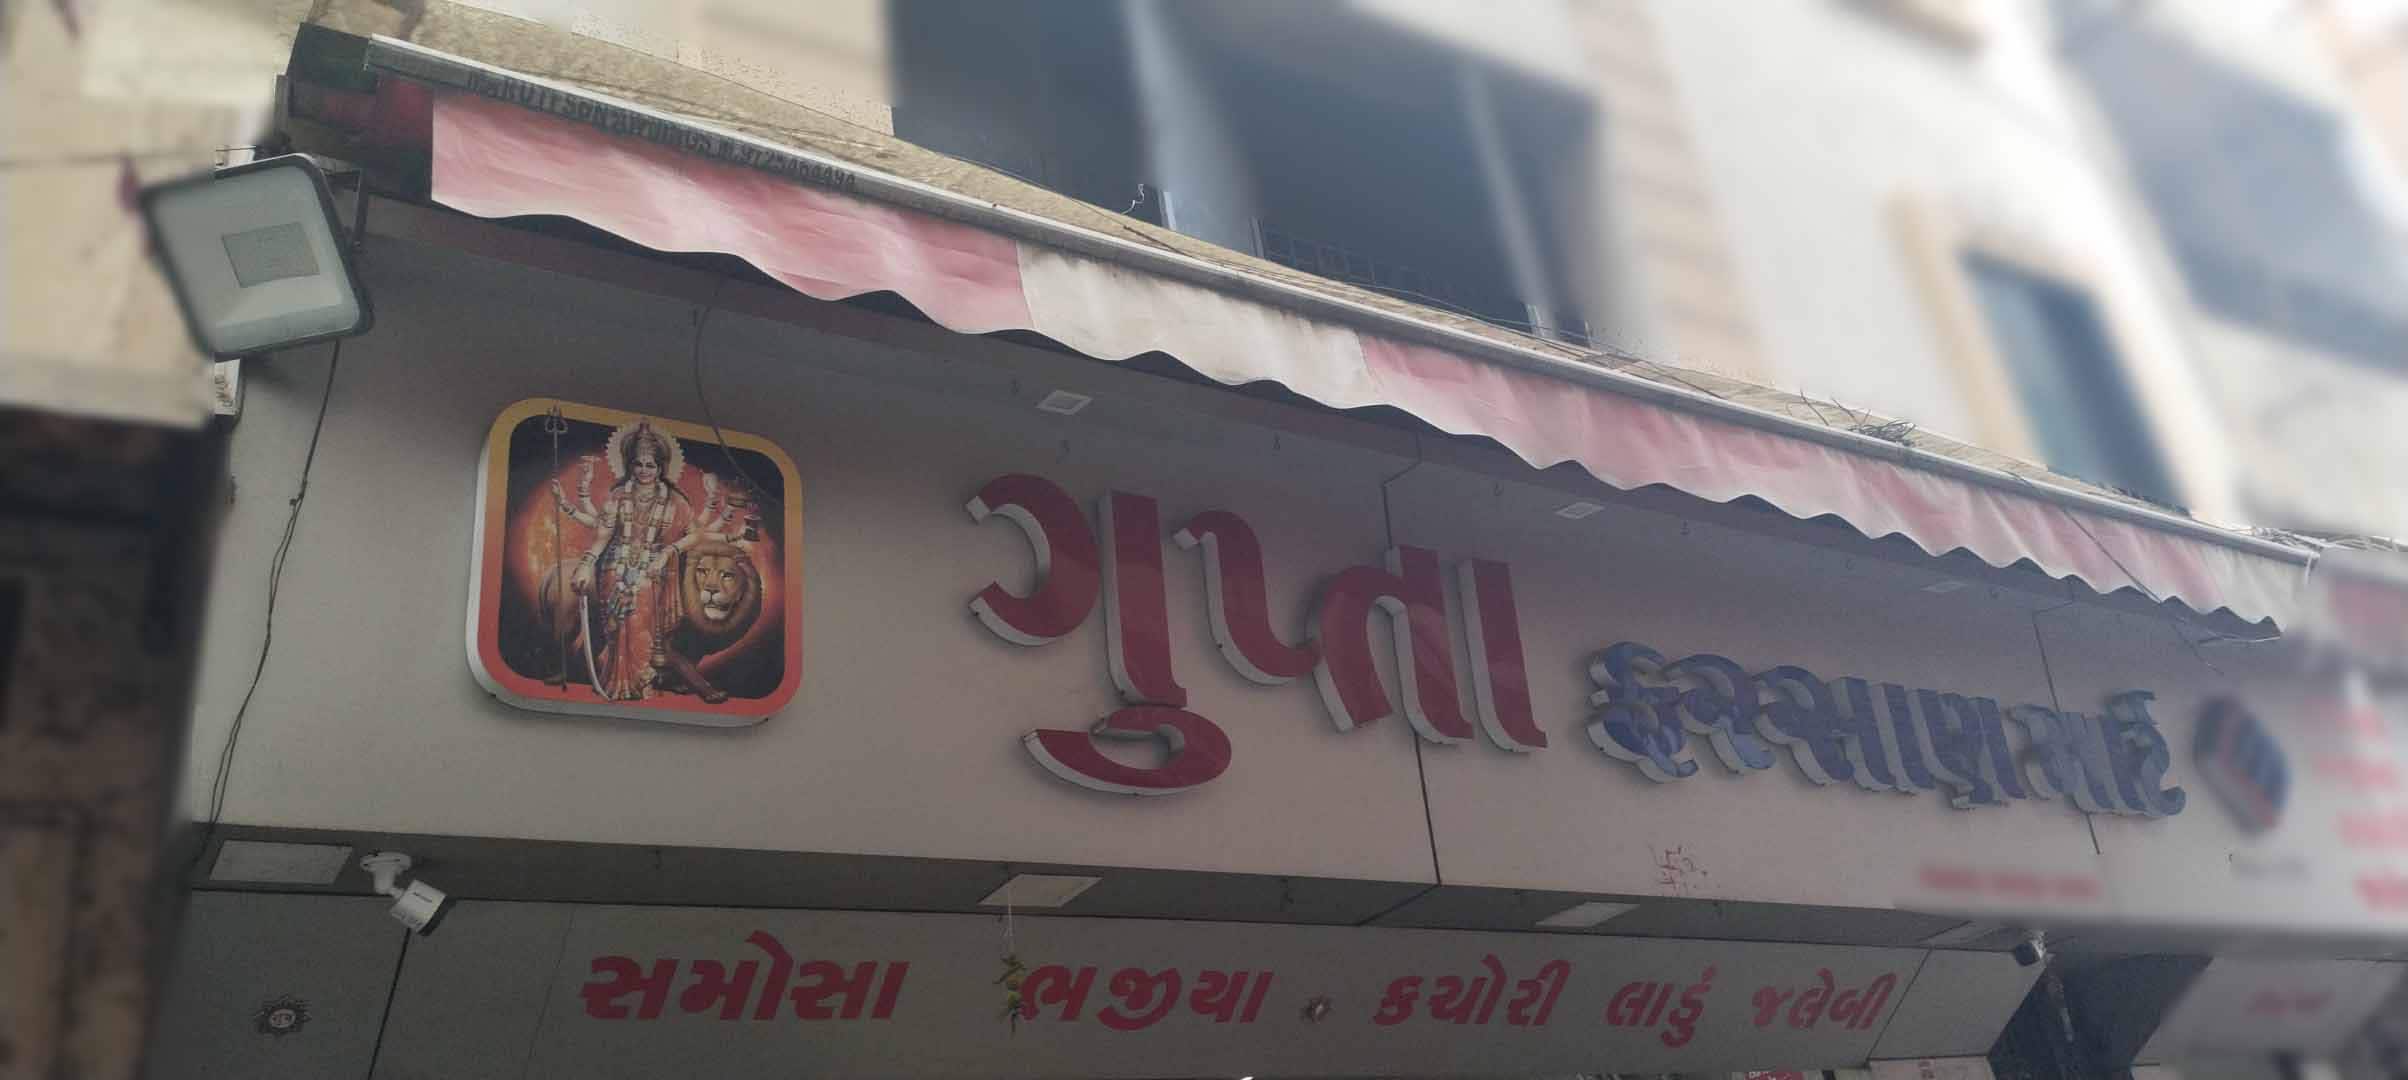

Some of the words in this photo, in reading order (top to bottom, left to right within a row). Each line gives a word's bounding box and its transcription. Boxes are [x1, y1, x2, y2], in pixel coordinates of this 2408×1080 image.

[966, 472, 1548, 797] ગુપ્તા
[1587, 640, 2028, 810] ફરસાણ
[580, 930, 909, 1021] સમોસા
[1018, 964, 1275, 1032] ભજીયા
[1373, 954, 1571, 1026] કચોરી
[1750, 967, 1898, 1030] જલેબી
